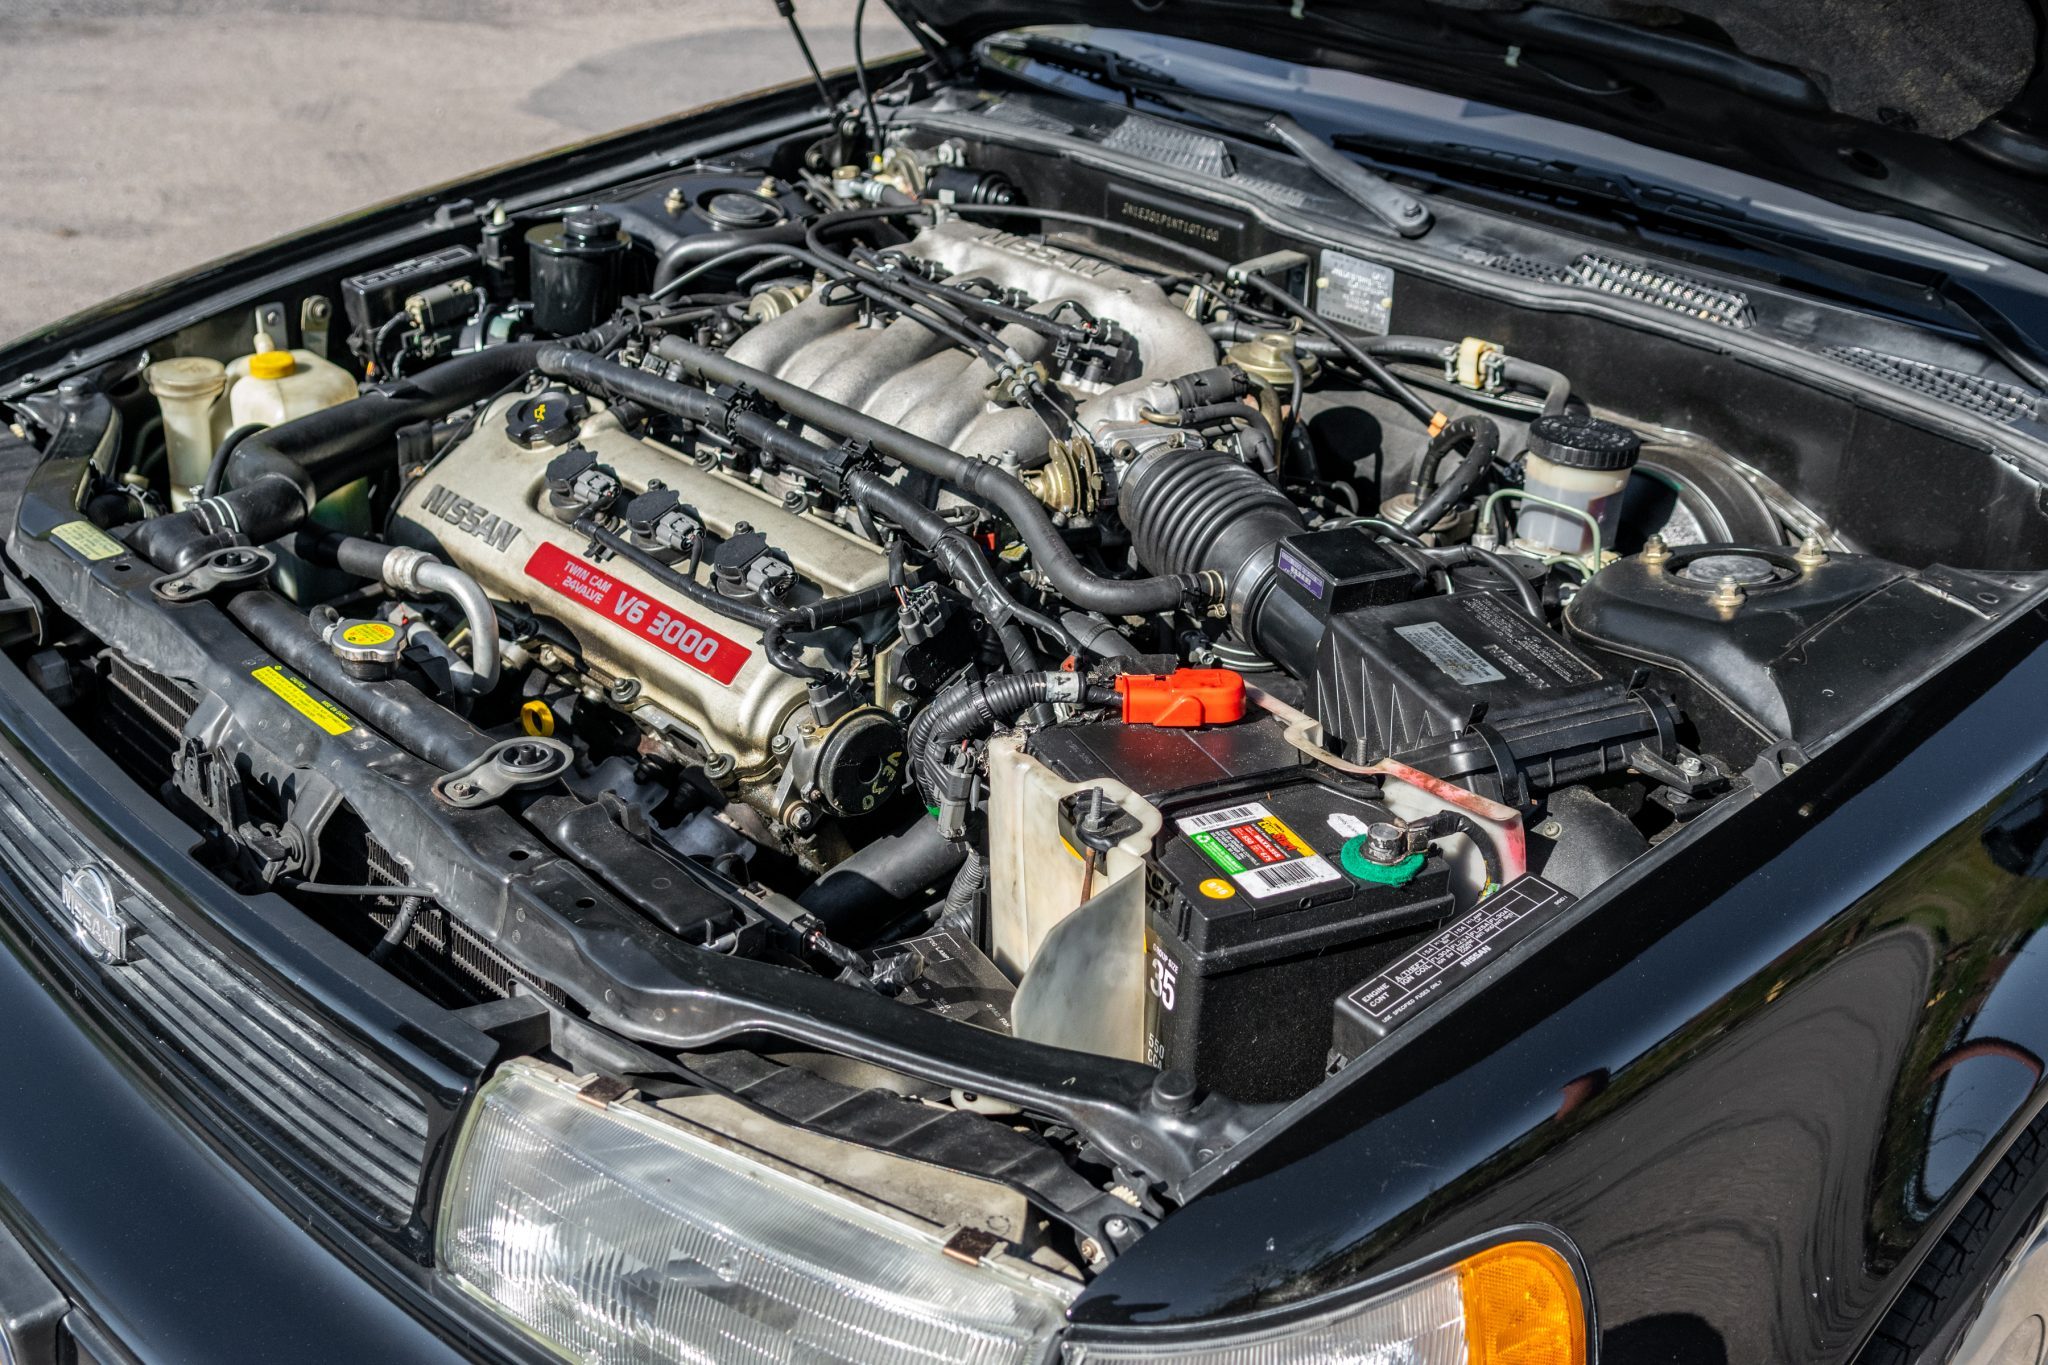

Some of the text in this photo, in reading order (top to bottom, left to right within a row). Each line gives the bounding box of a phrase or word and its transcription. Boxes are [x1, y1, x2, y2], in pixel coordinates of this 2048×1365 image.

[421, 484, 522, 553] NISSAN
[563, 560, 612, 593] TWIN CAM
[562, 575, 605, 605] 24VALVE
[613, 591, 719, 663] V6 3000
[1483, 644, 1551, 690] NISSAN
[1257, 821, 1298, 852] EverStart
[62, 887, 116, 952] NISSAN
[1469, 922, 1490, 936] FL25A
[1488, 910, 1508, 923] FL30A
[1454, 926, 1466, 934] 15A
[1152, 942, 1179, 975] GROUP SIZE
[1422, 948, 1434, 956] 15A
[1430, 948, 1451, 962] FL30A
[1460, 945, 1491, 967] NISSAN
[1395, 958, 1428, 982] A/THEFT
[1399, 962, 1432, 985] IGN COIL
[1150, 957, 1176, 1011] 35
[1362, 983, 1389, 1002] ENGINE
[1370, 992, 1389, 1007] CONT
[1382, 980, 1442, 1022] USE SPECIFIED FUSES ONLY
[1148, 1033, 1165, 1059] 550
[1147, 1048, 1163, 1071] CCA
